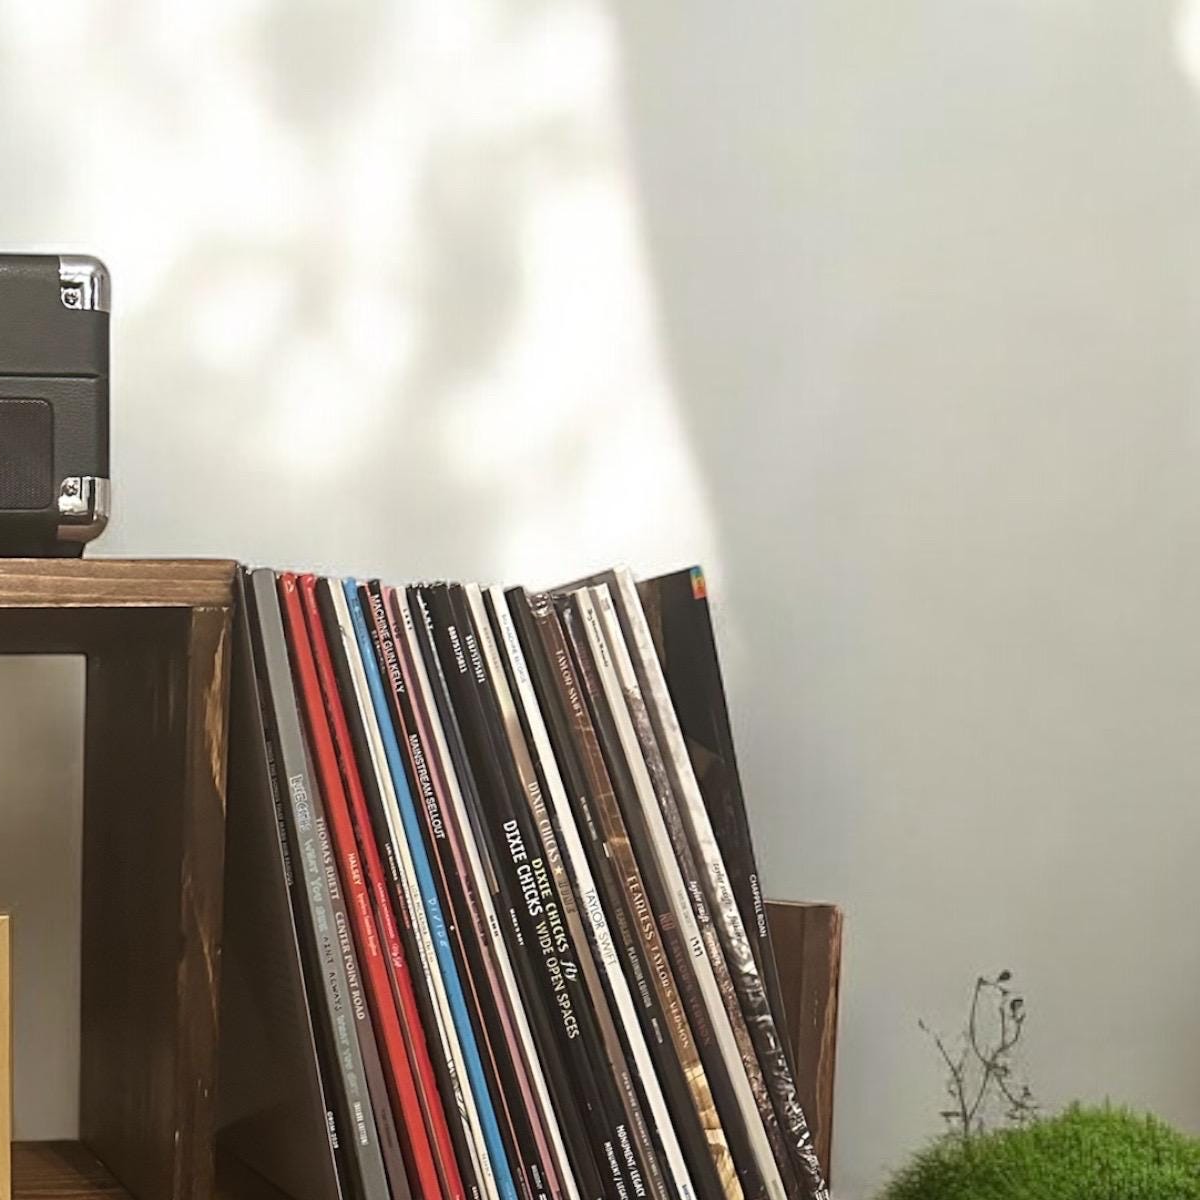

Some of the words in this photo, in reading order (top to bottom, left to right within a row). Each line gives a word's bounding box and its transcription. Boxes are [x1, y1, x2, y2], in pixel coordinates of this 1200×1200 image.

[369, 593, 390, 639] MACHINE
[382, 639, 396, 663] GUN
[388, 663, 404, 694] KELLY
[408, 734, 433, 796] MAINSTREAM
[425, 796, 445, 840] SELLOUT
[527, 782, 545, 817] DIXIE
[538, 819, 560, 862] CHICKS
[554, 649, 573, 686] TAYLOR
[566, 687, 583, 717] SWIFT
[625, 875, 656, 940] FEARLESS
[668, 1001, 690, 1048] VERSION
[346, 852, 361, 885] HALSEY
[688, 879, 704, 902] taylor
[302, 838, 319, 874] WHAT
[328, 971, 342, 1012] ALWAYS
[314, 816, 331, 864] THOMAS
[324, 865, 339, 900] RHETT
[334, 911, 350, 952] CENTER
[343, 954, 358, 989] POINT
[351, 990, 365, 1020] ROAD
[427, 897, 447, 947] DIVIDE
[502, 819, 527, 863] DIXIE
[515, 864, 543, 916] CHICKS
[534, 921, 554, 955] WIDE
[544, 956, 565, 991] OPEN
[555, 993, 579, 1039] SPACES
[530, 857, 552, 898] DIXIE
[544, 902, 569, 952] CHICKS
[559, 957, 579, 983] fly
[584, 888, 604, 928] TAYLOR
[597, 932, 616, 966] SWIFT
[748, 873, 762, 912] CHAPPELL
[756, 913, 766, 937] ROAN
[626, 946, 643, 980] PLATINUM
[637, 980, 652, 1007] EDITION
